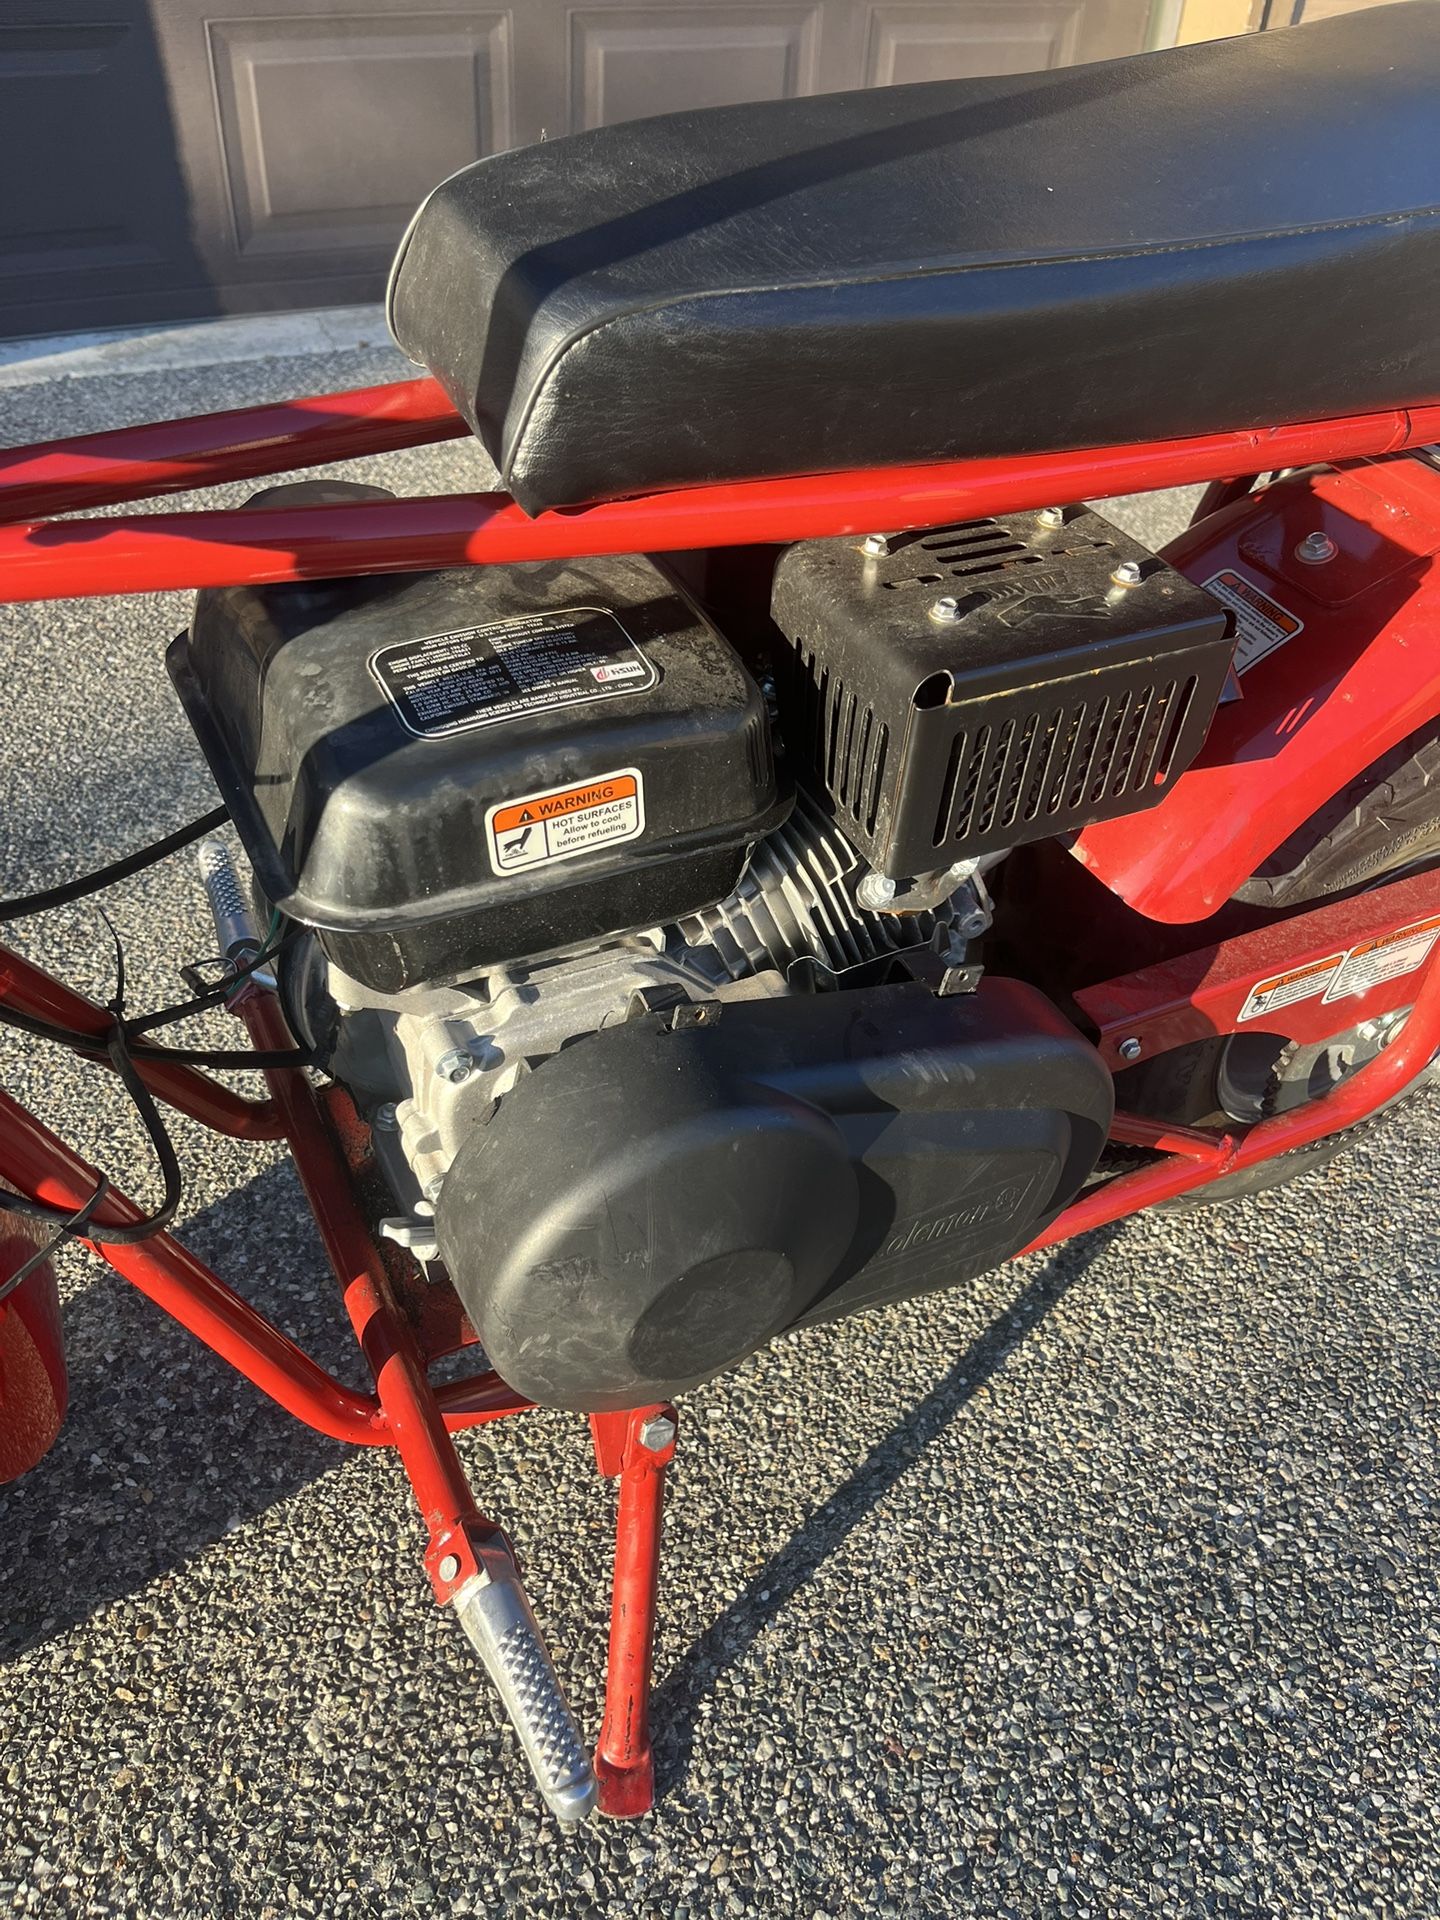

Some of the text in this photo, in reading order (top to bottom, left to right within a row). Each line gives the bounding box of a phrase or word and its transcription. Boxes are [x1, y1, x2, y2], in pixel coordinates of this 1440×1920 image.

[1242, 587, 1283, 620] WARNING
[424, 637, 449, 645] VEHICLE
[449, 631, 476, 639] EMISSION
[477, 625, 504, 634] CONTROL
[420, 667, 442, 675] VEHICLE
[489, 708, 510, 716] SCIENCE
[493, 701, 518, 710] VEHICLES
[538, 786, 614, 815] WARNING
[552, 801, 632, 829] HOT SURFACES
[563, 822, 589, 836] Allow
[602, 813, 621, 825] cool
[557, 822, 627, 847] before refueling
[880, 1201, 990, 1257] oleman
